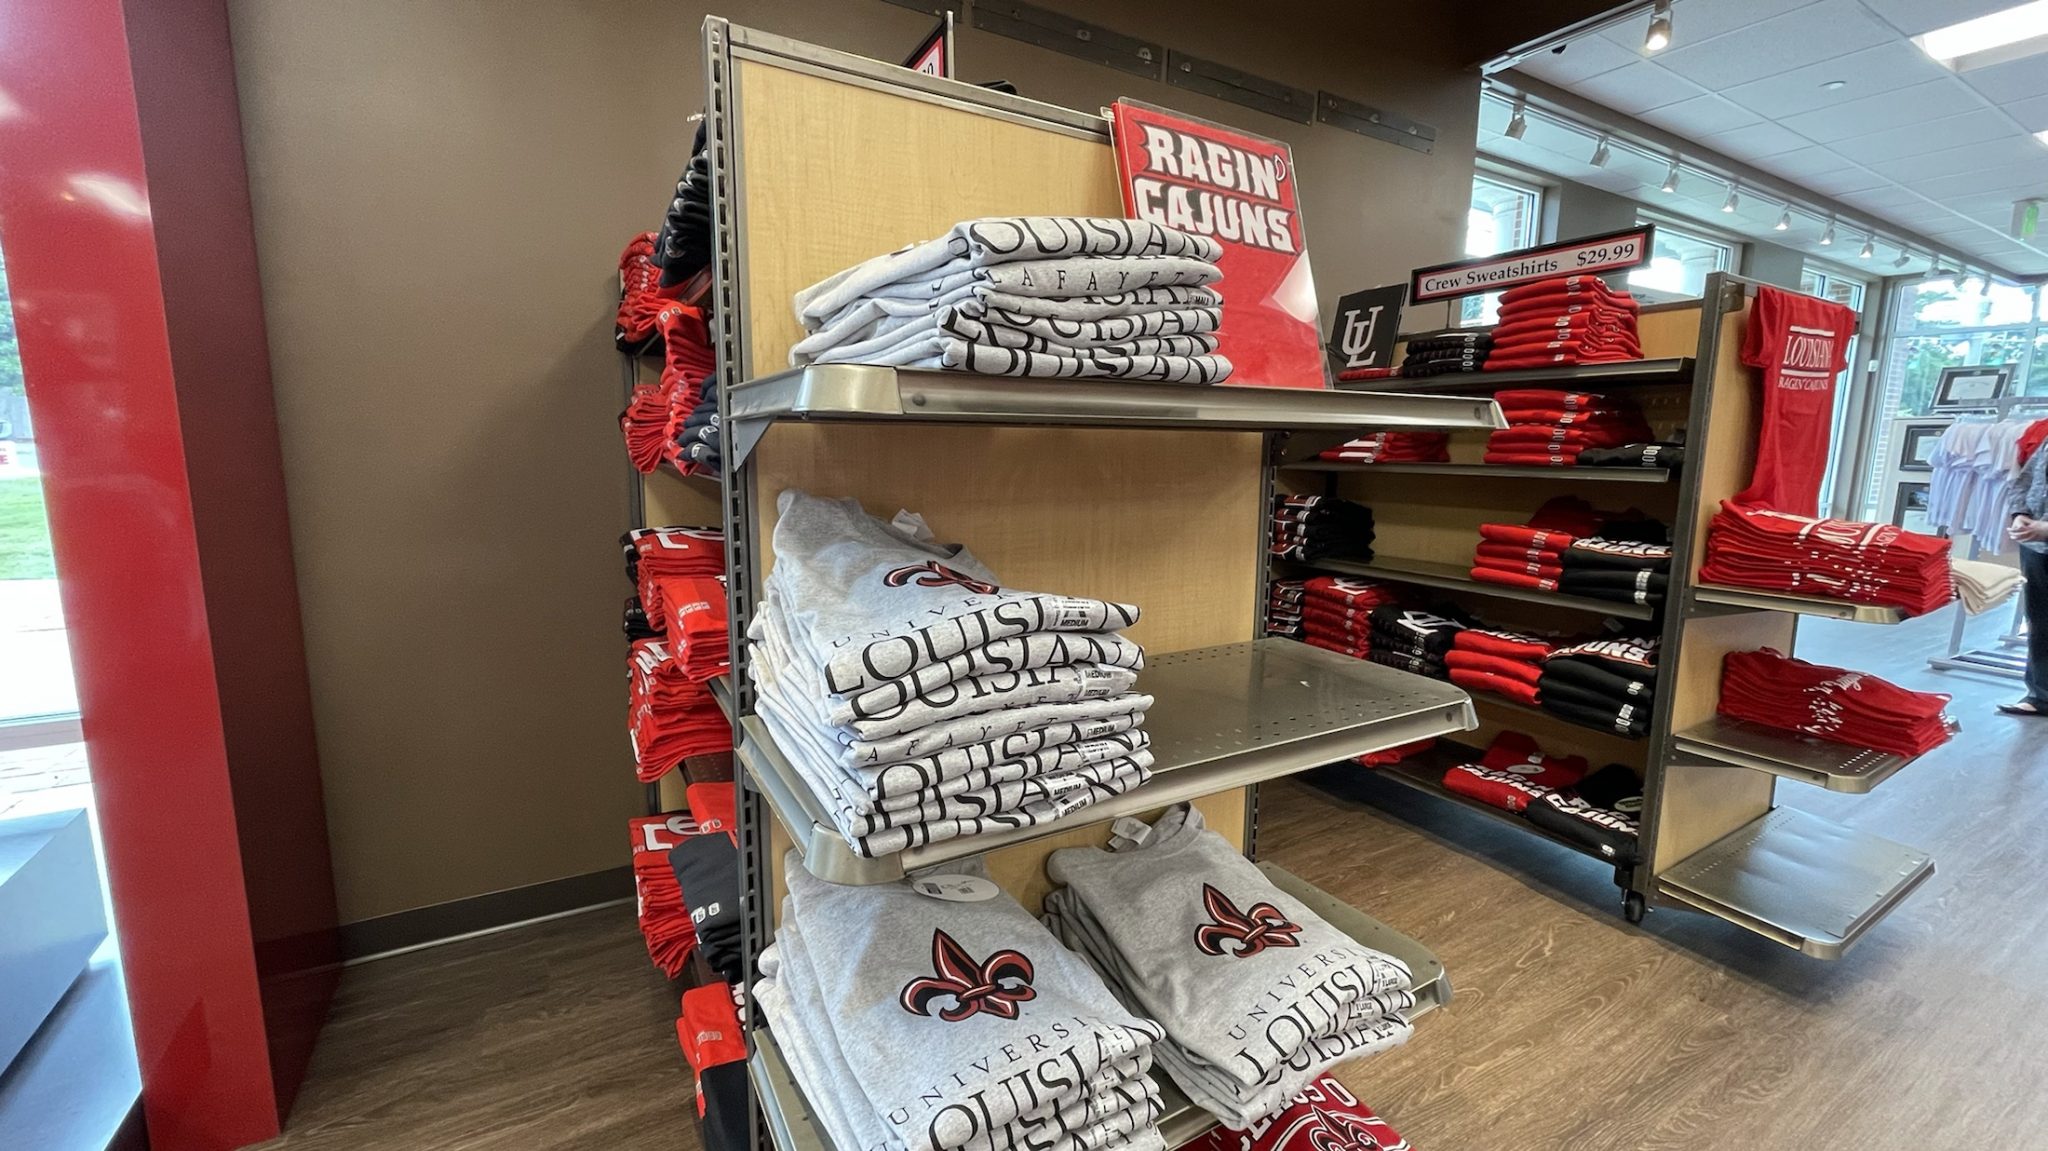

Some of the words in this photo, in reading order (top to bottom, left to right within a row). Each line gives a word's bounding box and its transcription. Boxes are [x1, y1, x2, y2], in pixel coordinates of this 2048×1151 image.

[1134, 177, 1297, 254] CAJUNS
[1425, 276, 1462, 293] Crew
[1466, 258, 1558, 285] Sweatshirts
[1576, 243, 1635, 268] $29.99
